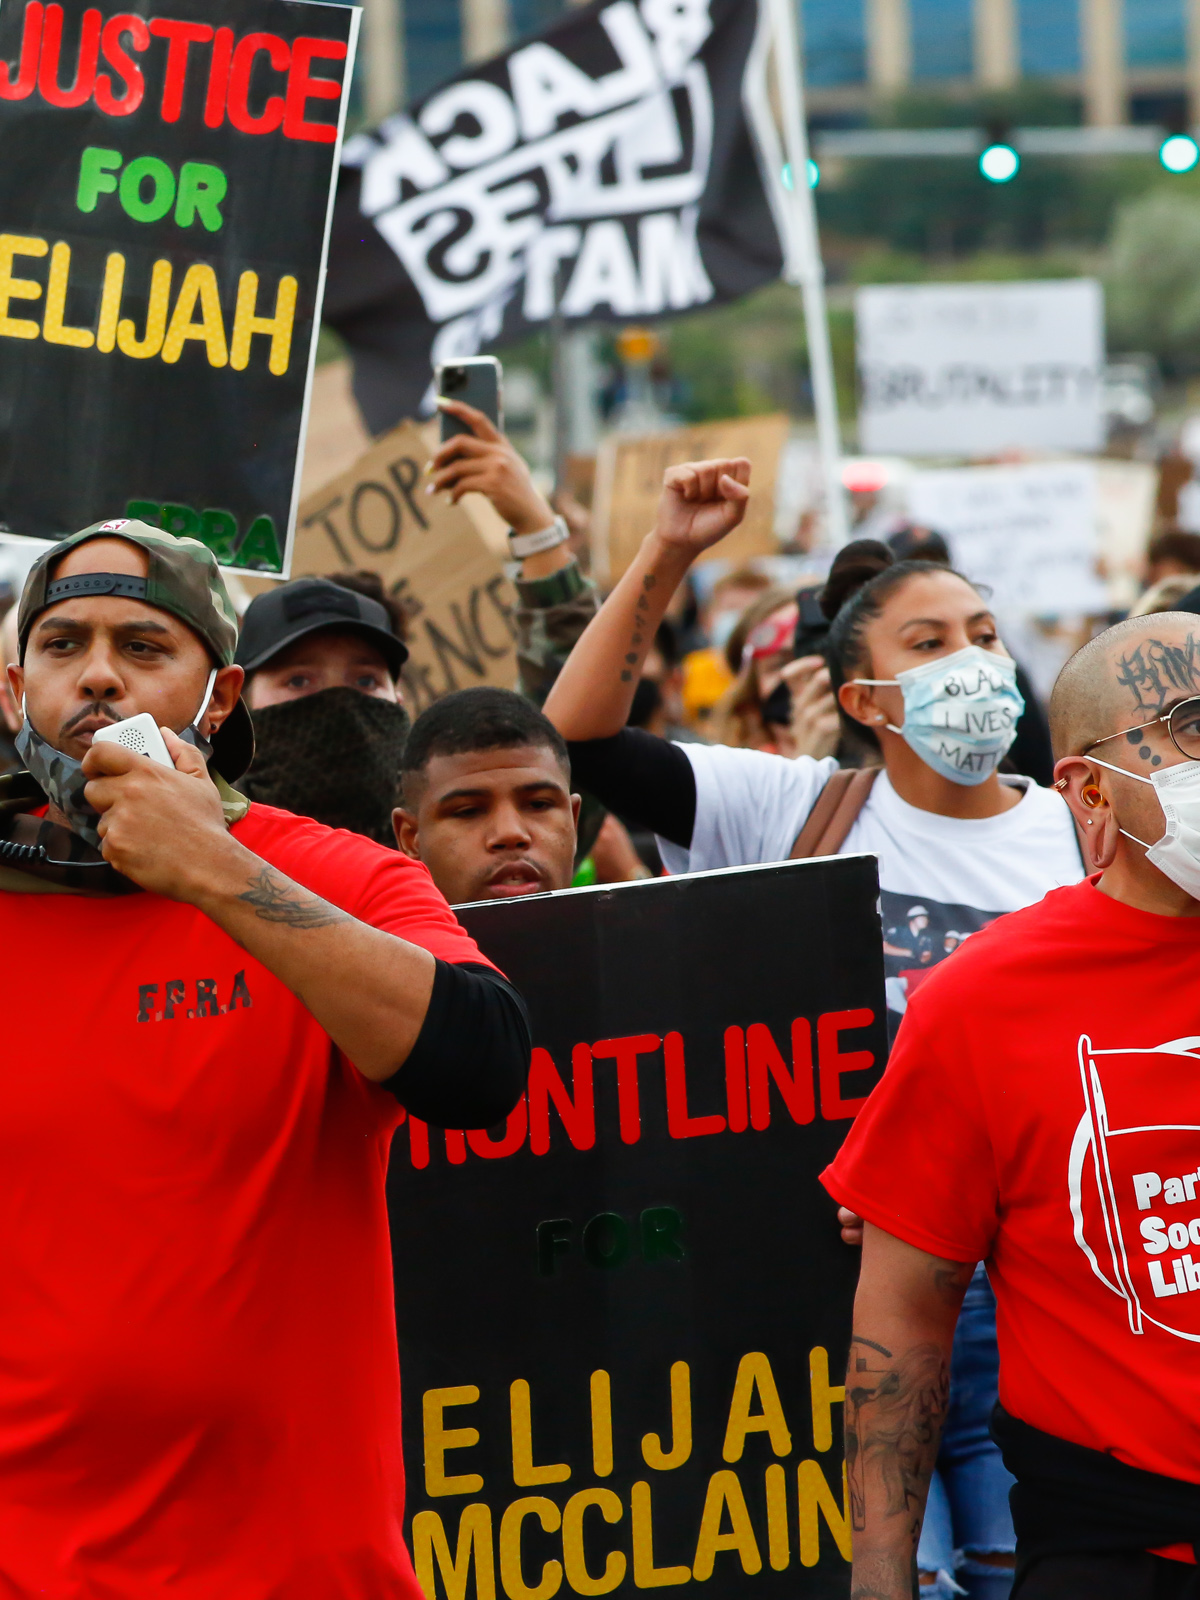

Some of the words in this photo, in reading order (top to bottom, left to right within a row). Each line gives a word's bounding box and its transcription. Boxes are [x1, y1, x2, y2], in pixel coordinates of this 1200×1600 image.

[76, 146, 228, 233] FOR
[302, 456, 430, 567] TOP
[408, 1008, 875, 1170] NTLINE
[1132, 1166, 1200, 1211] Par
[536, 1206, 685, 1277] FOR
[412, 1459, 852, 1600] MCCLAIN
